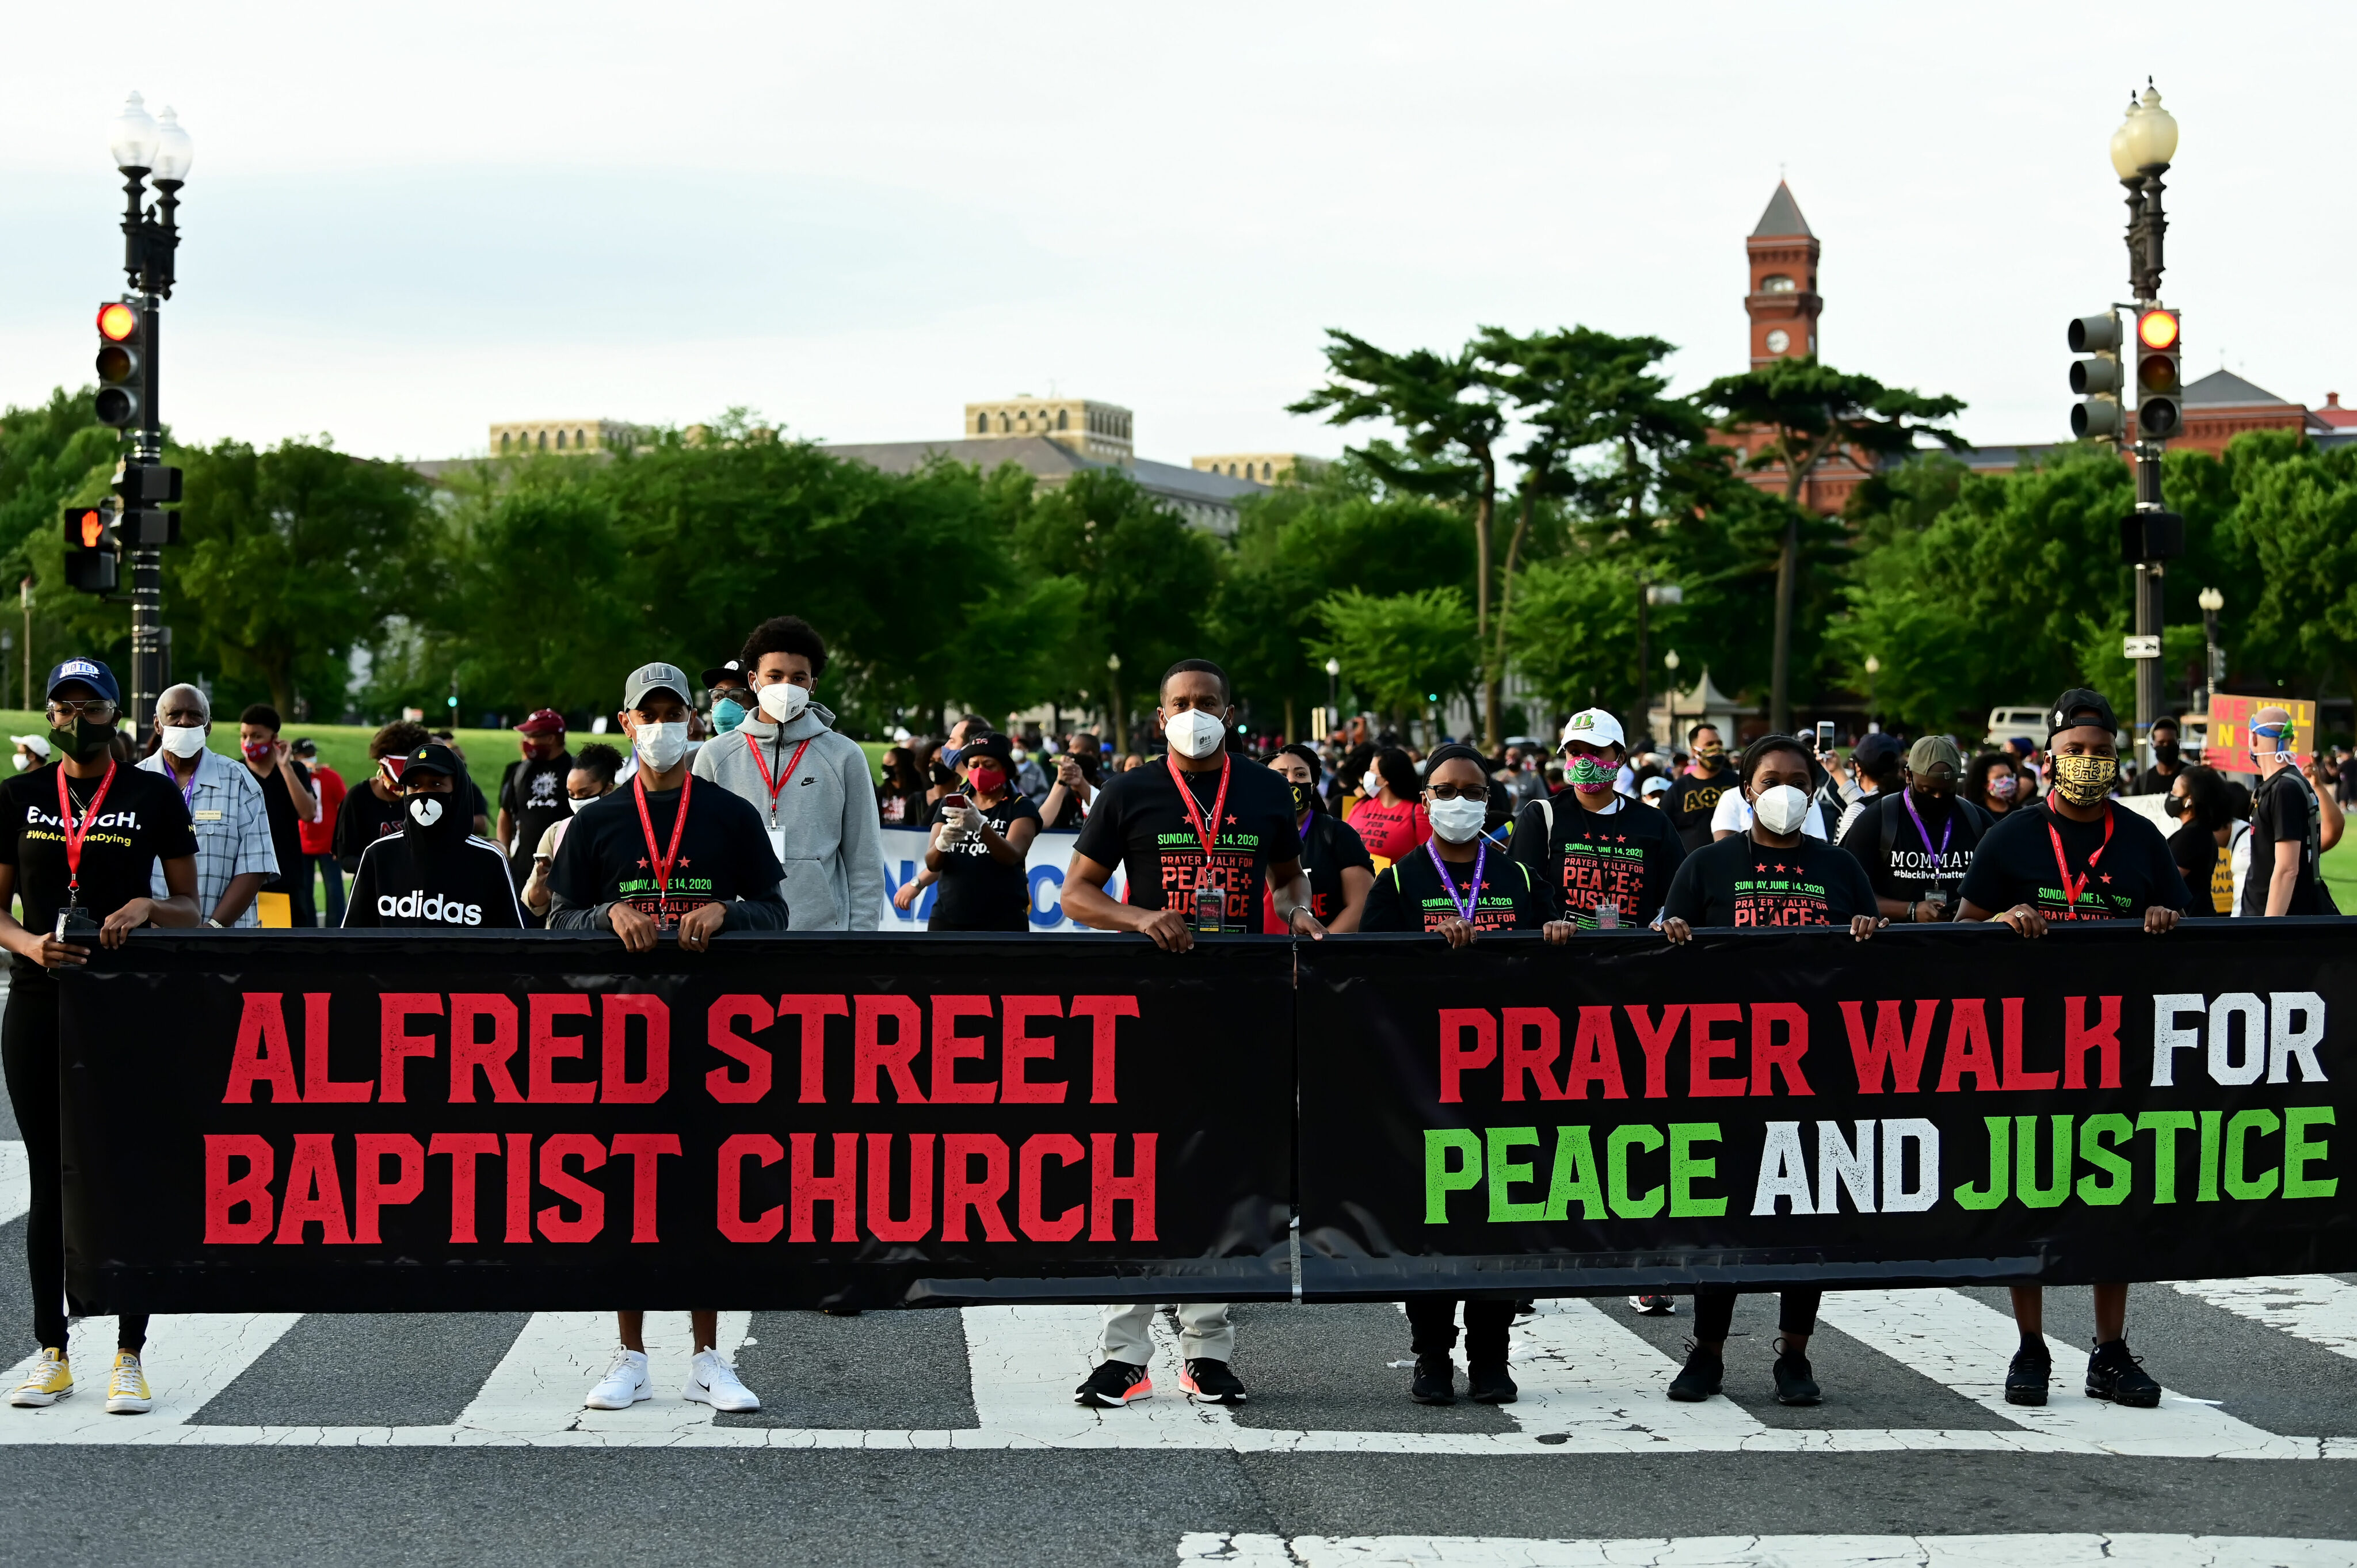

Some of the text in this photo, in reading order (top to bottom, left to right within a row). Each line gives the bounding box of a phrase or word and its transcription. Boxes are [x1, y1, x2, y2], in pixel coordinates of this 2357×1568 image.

[2213, 699, 2248, 720] WE
[2218, 723, 2249, 747] NO
[26, 830, 131, 846] #WeAreneDying
[1158, 833, 1196, 845] SUNDAY,
[1222, 834, 1235, 845] 14,
[1237, 834, 1258, 846] 2020
[1361, 838, 1383, 848] VES
[1565, 843, 1594, 852] SUNDAY,
[1614, 847, 1624, 856] 14,
[1626, 849, 1643, 858] 2020
[1161, 856, 1202, 865] PRAYER
[1238, 857, 1253, 868] FOR
[1564, 857, 1597, 868] PRAYER
[1629, 864, 1644, 874] FOR
[1894, 869, 1966, 879] #blacklivematter
[619, 878, 712, 892] SUNDAY, JUE 14, 2020
[1769, 881, 1789, 890] JUNE
[1804, 884, 1825, 894] 2020
[1161, 891, 1249, 917] JUSCE
[1421, 898, 1455, 907] SUNDAY,
[1478, 897, 1490, 906] 14,
[1491, 896, 1513, 906] 2020
[2038, 887, 2066, 901] SUNDA
[2076, 892, 2094, 903] UNE
[2111, 895, 2131, 907] 020
[377, 890, 482, 925] adidas
[1736, 899, 1774, 909] PRAER
[1810, 901, 1828, 911] FOR
[1424, 913, 1516, 925] PRAY ALK FOR
[2038, 910, 2077, 921] PRAYE
[221, 993, 1141, 1104] ALFRED STREET
[1438, 991, 2329, 1103] PRAYER WALK FOR
[1423, 1106, 2339, 1224] PEACE AND JUSTICE
[203, 1132, 1159, 1245] BAPTIST CHURCH
